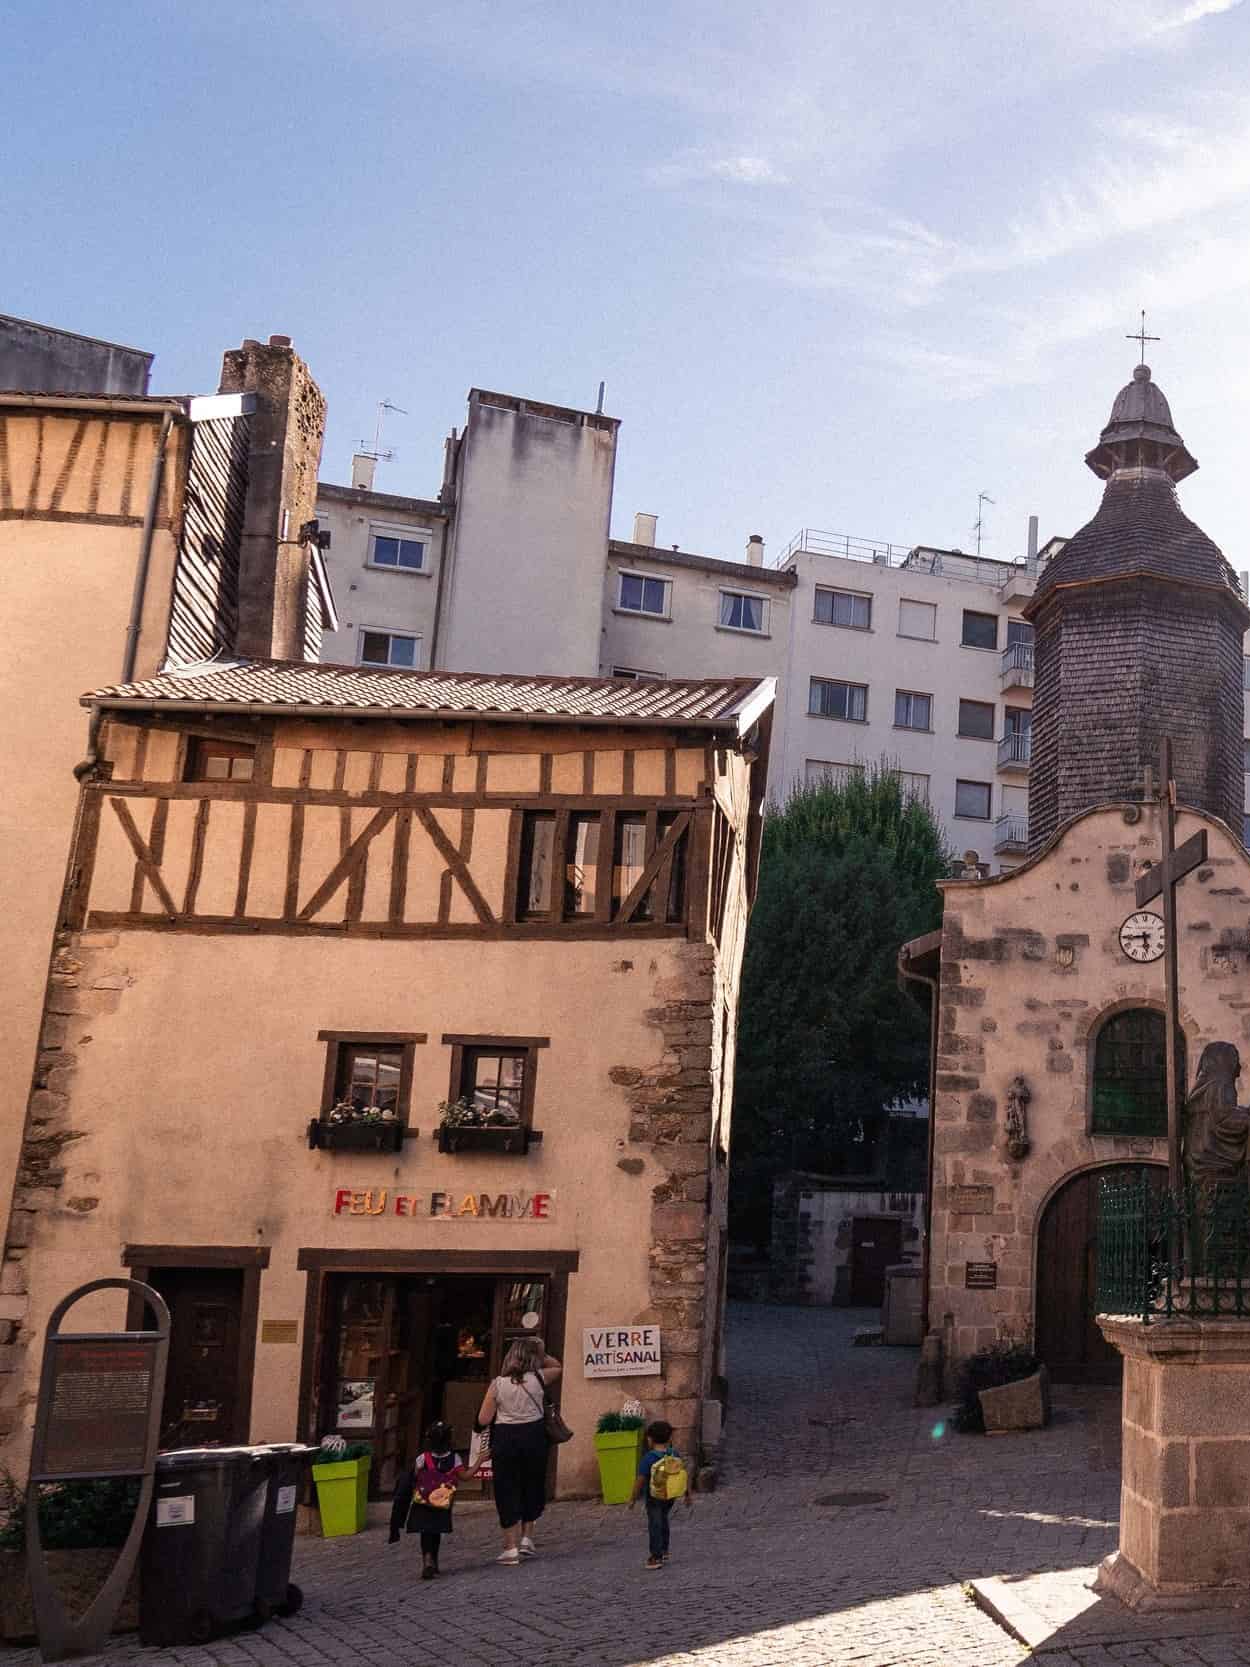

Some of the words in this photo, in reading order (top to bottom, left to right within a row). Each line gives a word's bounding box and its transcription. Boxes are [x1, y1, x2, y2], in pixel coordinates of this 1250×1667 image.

[333, 1190, 387, 1216] FEU
[395, 1196, 417, 1216] ET
[430, 1192, 551, 1218] FLAMME
[590, 1330, 654, 1349] VERRE
